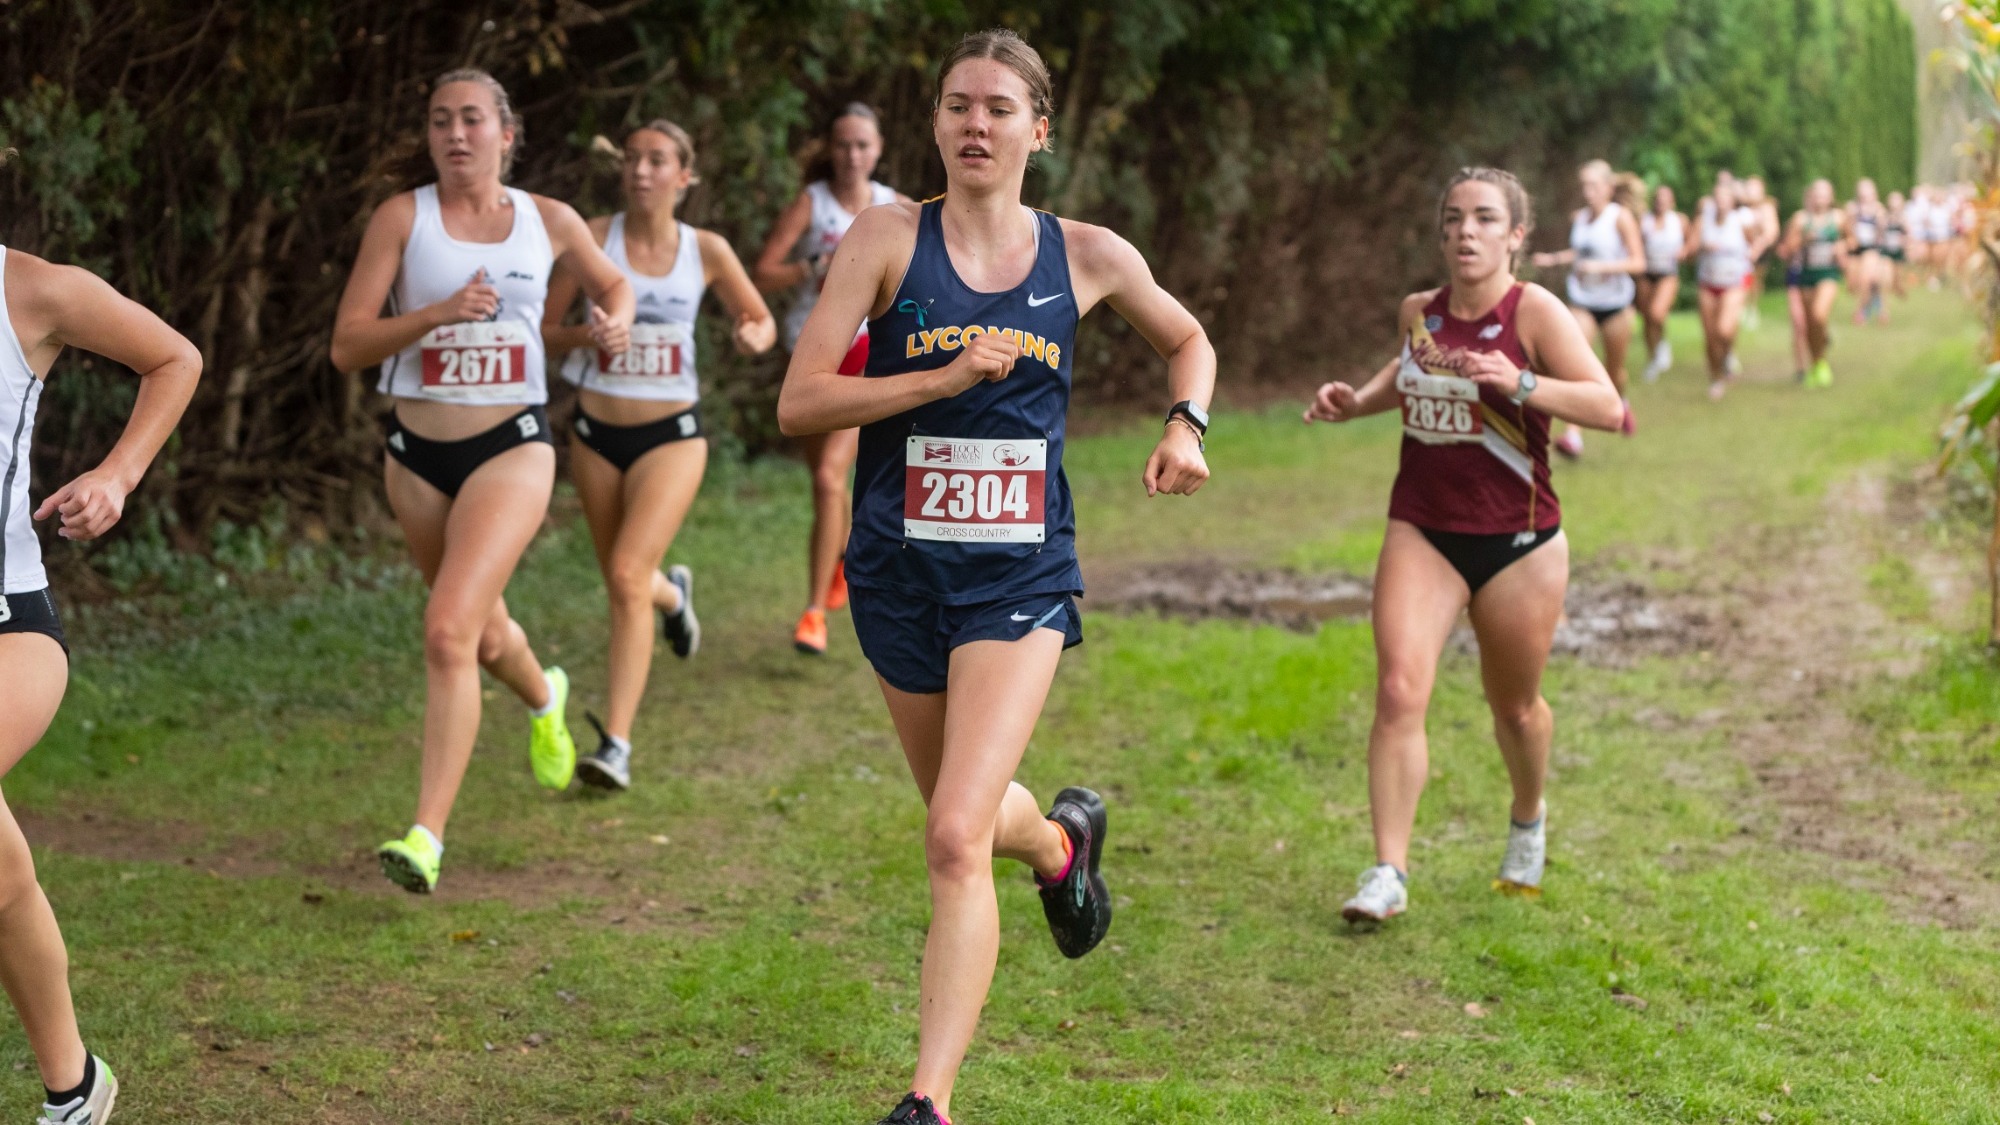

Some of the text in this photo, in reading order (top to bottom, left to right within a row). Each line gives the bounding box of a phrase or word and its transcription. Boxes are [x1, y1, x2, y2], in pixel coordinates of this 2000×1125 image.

[439, 347, 512, 384] 2671
[516, 414, 540, 438] B
[1405, 395, 1473, 433] 2826
[953, 444, 981, 454] LOCK
[953, 452, 981, 460] HAVEN
[921, 472, 1029, 519] 2304
[936, 526, 1012, 538] CROSS COUNTRY
